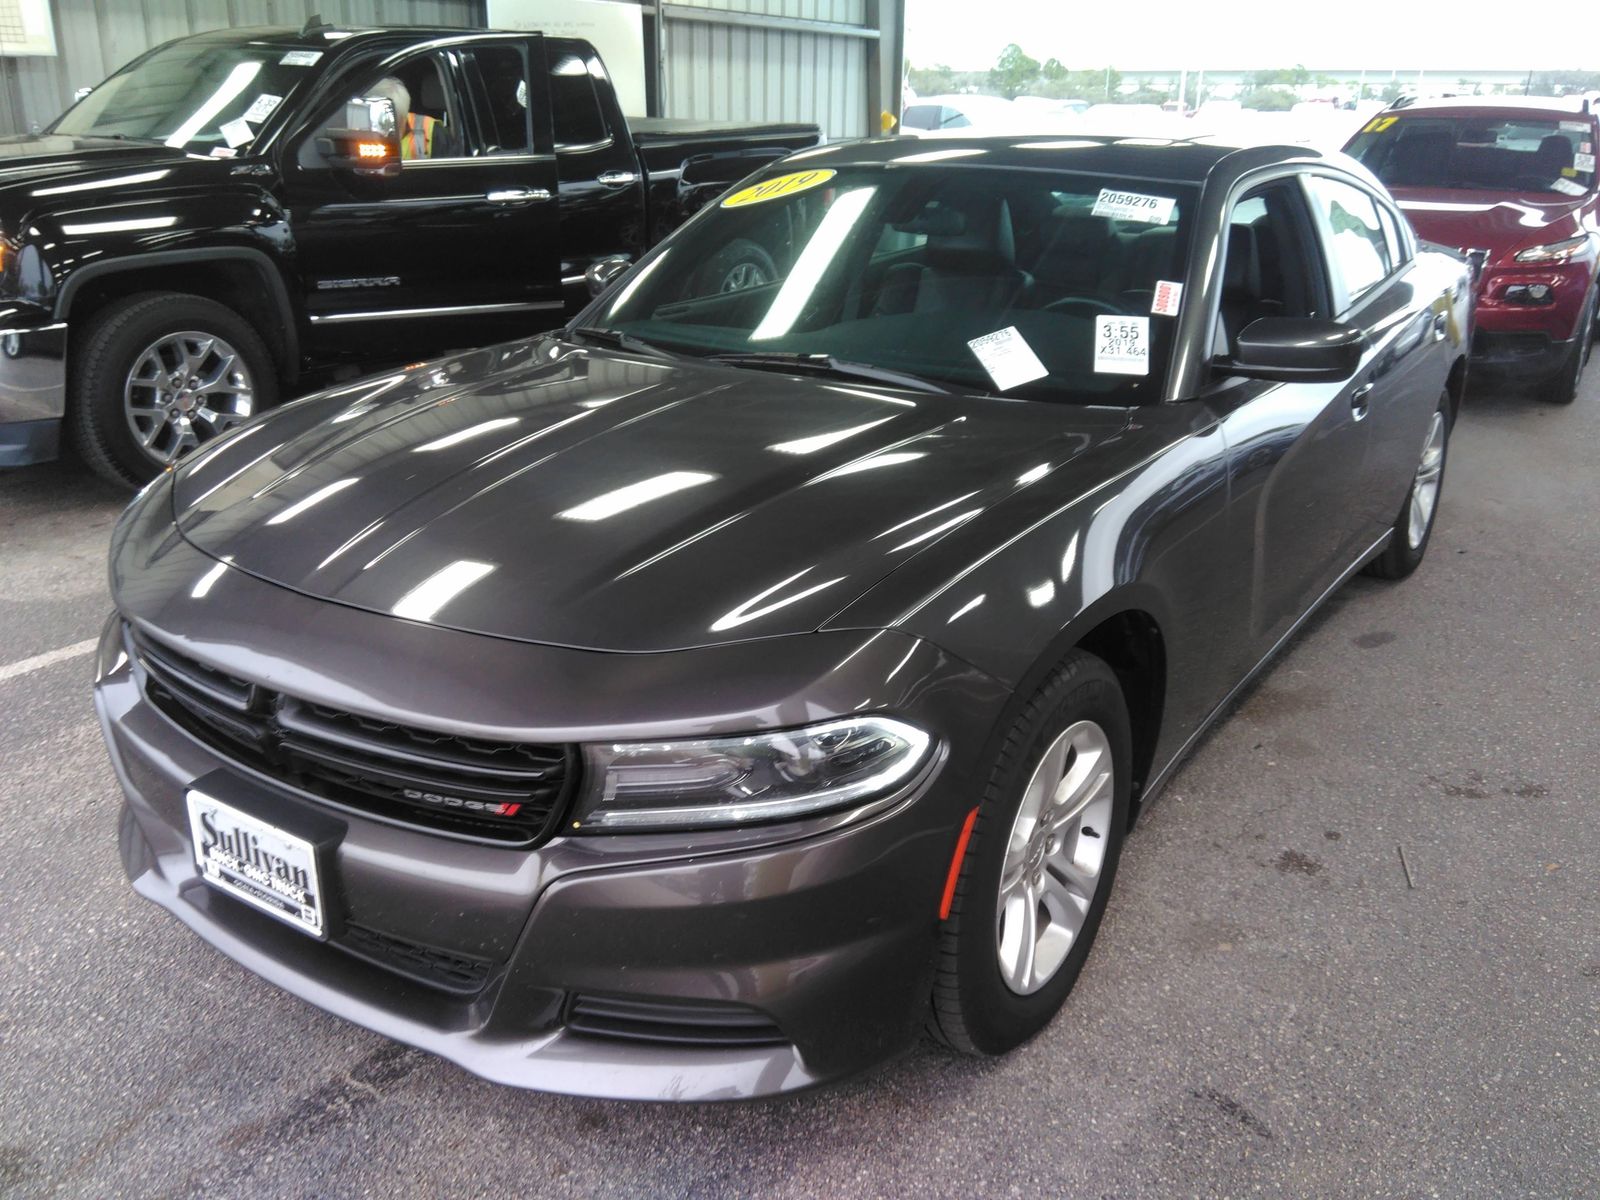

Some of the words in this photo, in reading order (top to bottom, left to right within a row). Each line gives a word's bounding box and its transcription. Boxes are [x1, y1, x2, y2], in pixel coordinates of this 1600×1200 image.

[736, 172, 820, 203] 2019
[1099, 191, 1159, 209] 2059276
[317, 276, 401, 290] SIERRA
[1103, 324, 1139, 339] 3:55
[1108, 338, 1136, 348] 2019
[403, 789, 506, 816] DODGE
[200, 809, 310, 892] Sullivan
